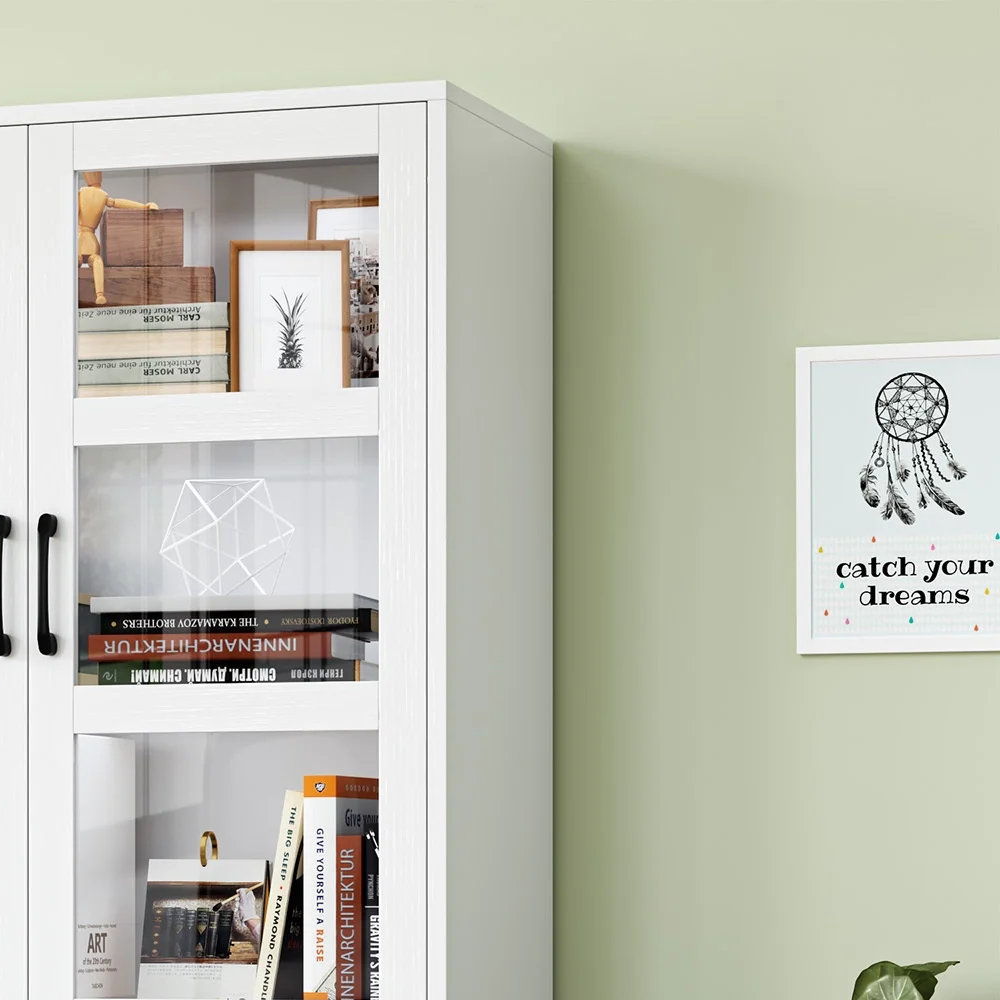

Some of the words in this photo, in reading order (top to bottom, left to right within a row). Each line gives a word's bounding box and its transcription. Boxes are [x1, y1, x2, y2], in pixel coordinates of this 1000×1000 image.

[154, 306, 201, 314] Architektur
[119, 362, 137, 370] eine
[143, 368, 174, 376] MOSER
[836, 556, 917, 578] catch
[923, 560, 994, 583] your
[859, 585, 970, 606] dreams
[122, 619, 175, 628] BROTHERS
[178, 618, 236, 628] KARAMAZOV
[239, 618, 258, 626] THE
[104, 638, 297, 654] INNENARCHITEKTUR
[131, 668, 182, 685] СНИМАЙ!
[184, 666, 227, 685] ДУМАЙ.
[229, 668, 277, 682] СМОТРИ.
[291, 669, 318, 678] КЭРОЛ
[320, 668, 344, 678] ГЕНРИ
[345, 808, 361, 827] Give
[316, 828, 324, 854] GIVE
[280, 852, 290, 880] SLEEP
[316, 858, 324, 914] YOURSELF
[270, 896, 282, 950] RAYMOND
[87, 932, 108, 954] ART
[316, 929, 324, 962] RAISE
